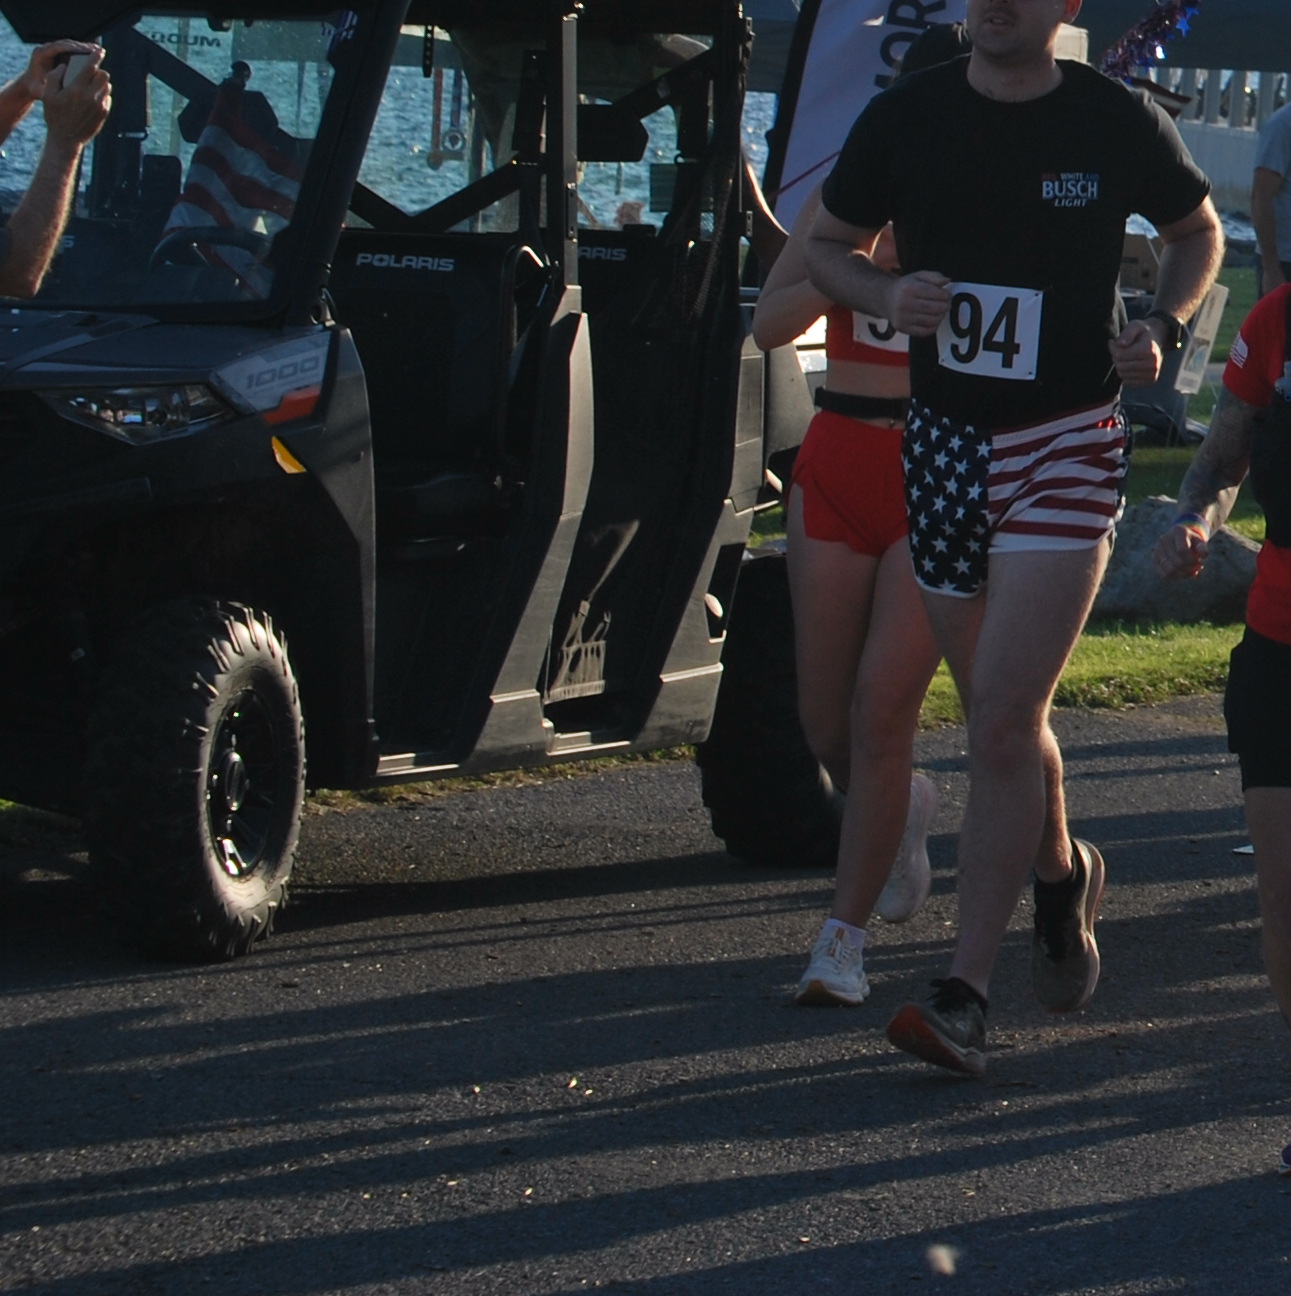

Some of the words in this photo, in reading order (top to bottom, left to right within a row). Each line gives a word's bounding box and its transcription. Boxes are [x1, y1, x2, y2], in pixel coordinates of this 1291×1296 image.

[1042, 180, 1099, 200] BUSCH
[1054, 198, 1087, 207] LIGHT
[355, 253, 455, 272] POLARIS
[951, 292, 1020, 369] 94
[246, 355, 319, 390] 1000
